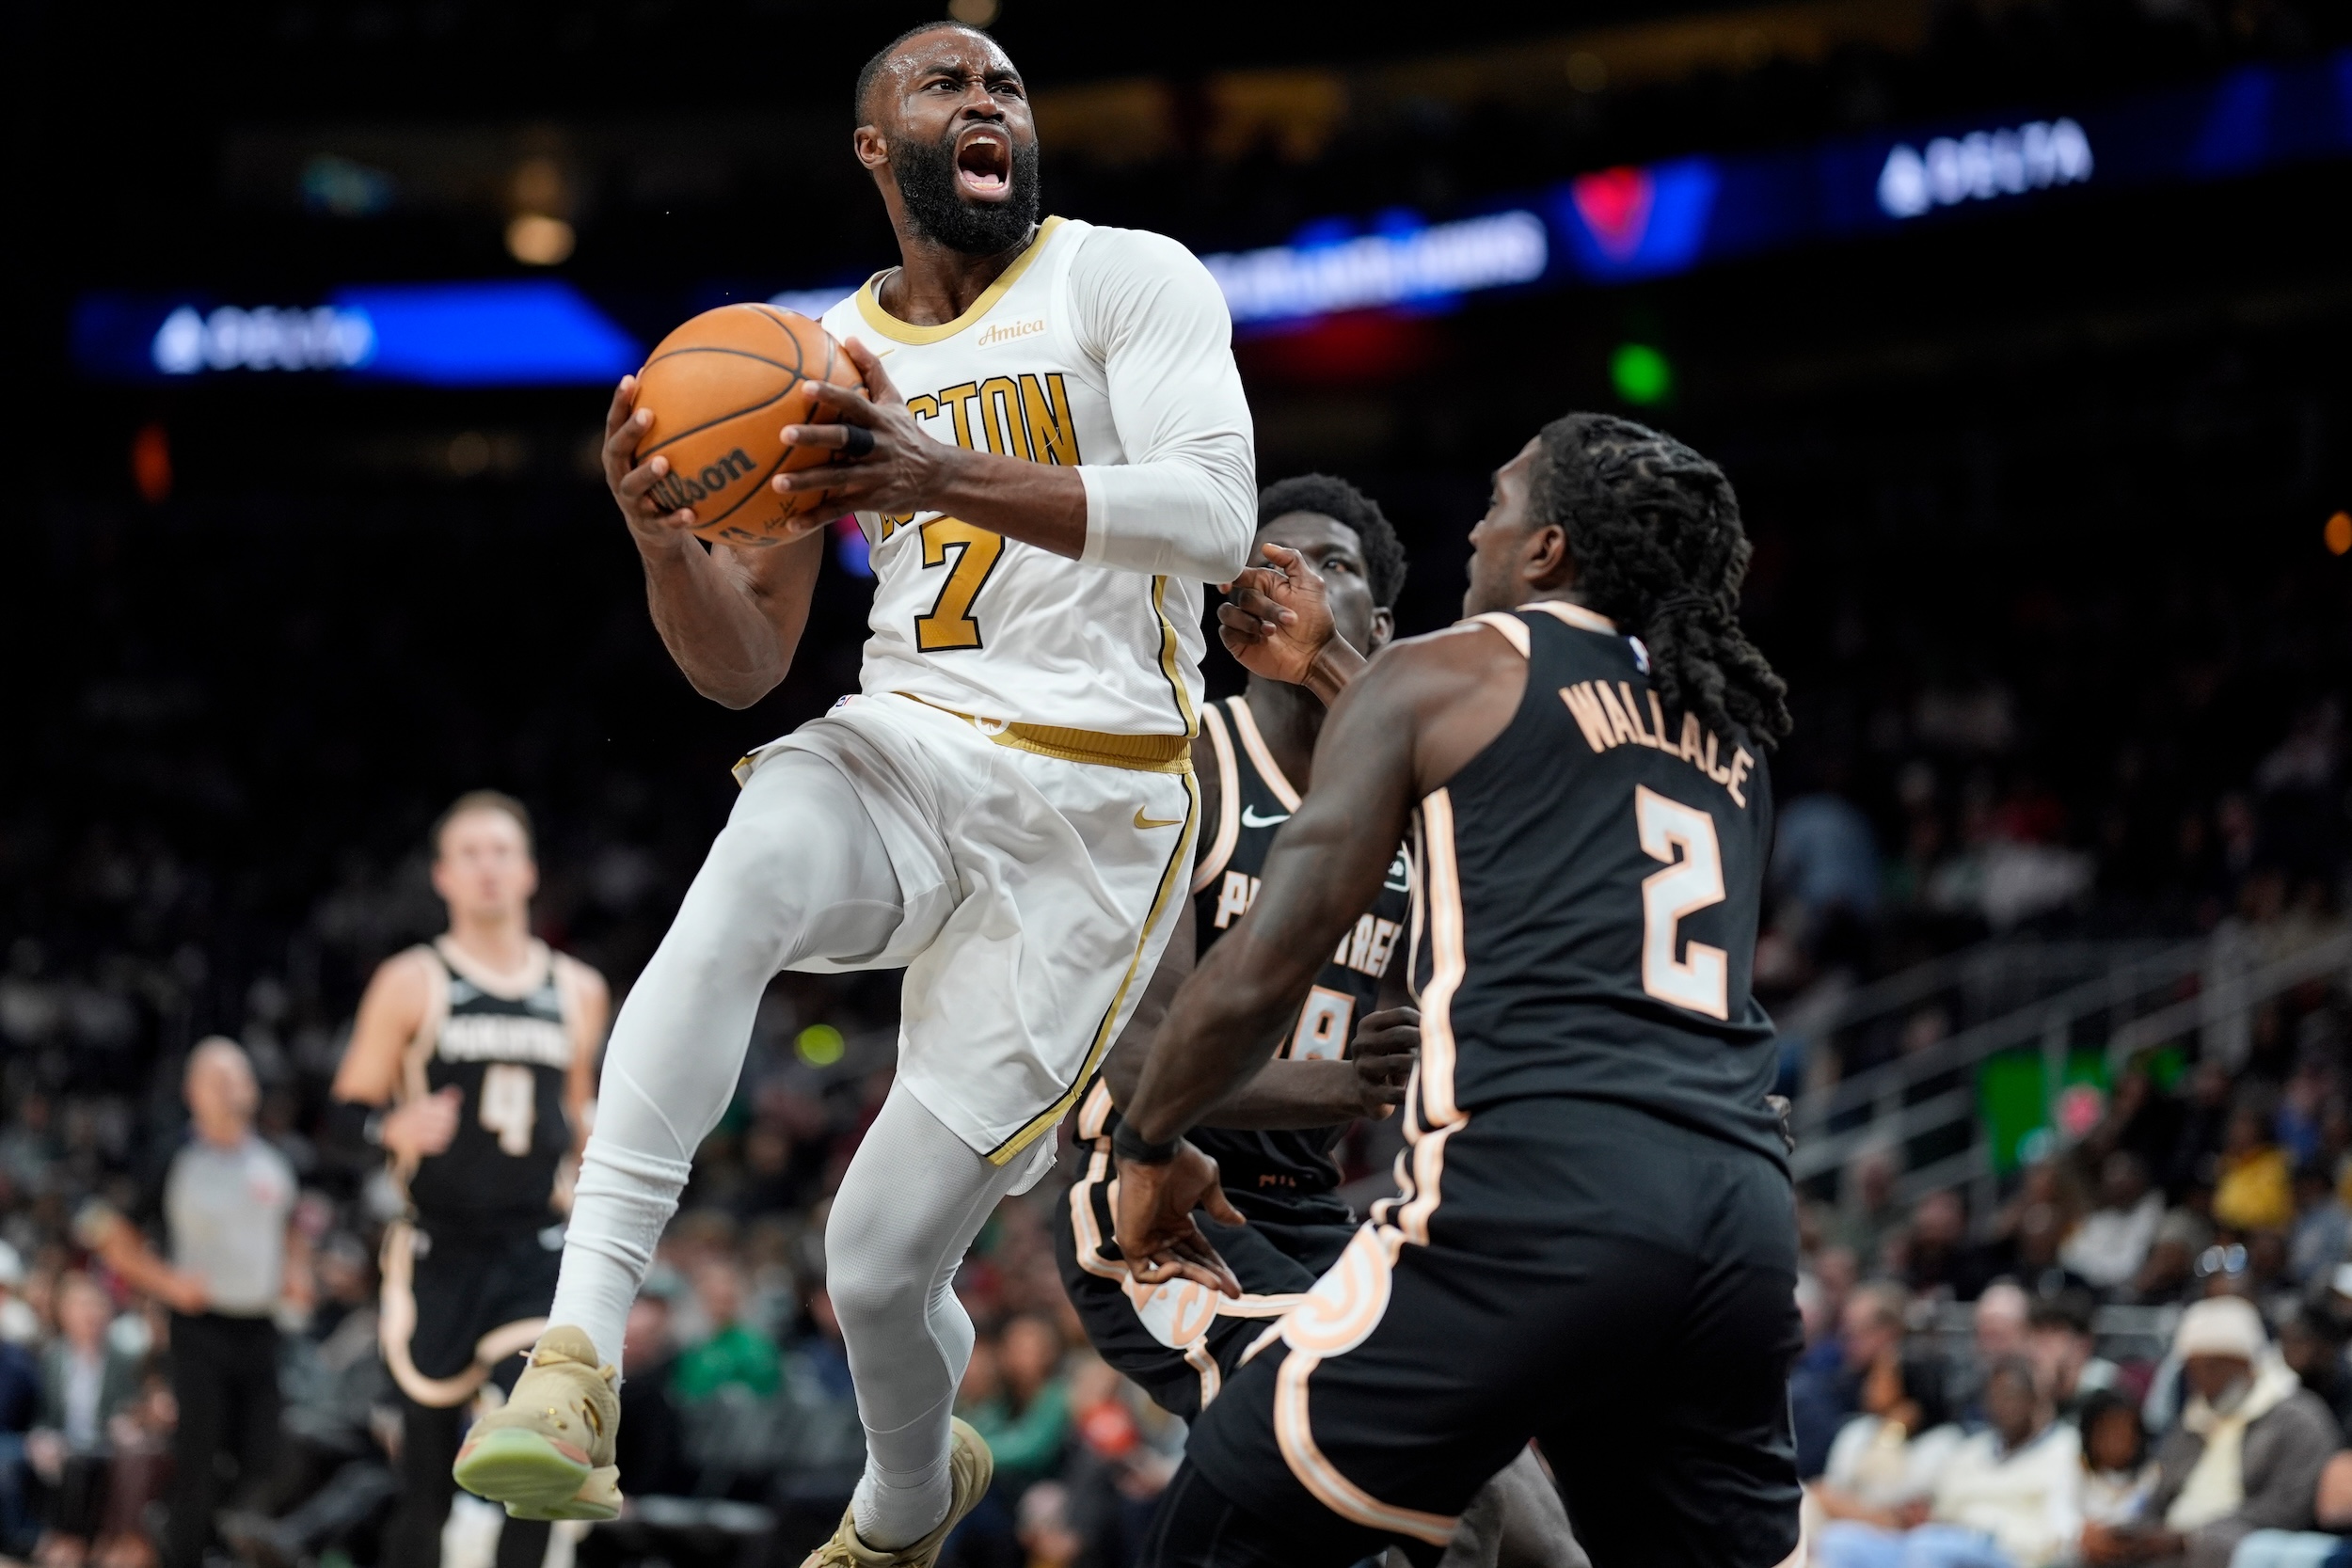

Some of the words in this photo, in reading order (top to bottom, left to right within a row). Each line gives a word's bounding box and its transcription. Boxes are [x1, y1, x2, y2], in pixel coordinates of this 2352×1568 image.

[977, 318, 1044, 347] Amica
[914, 514, 1006, 654] 7
[1558, 679, 1756, 809] WALLACE
[1634, 783, 1729, 1022] 2
[479, 1063, 535, 1157] 4
